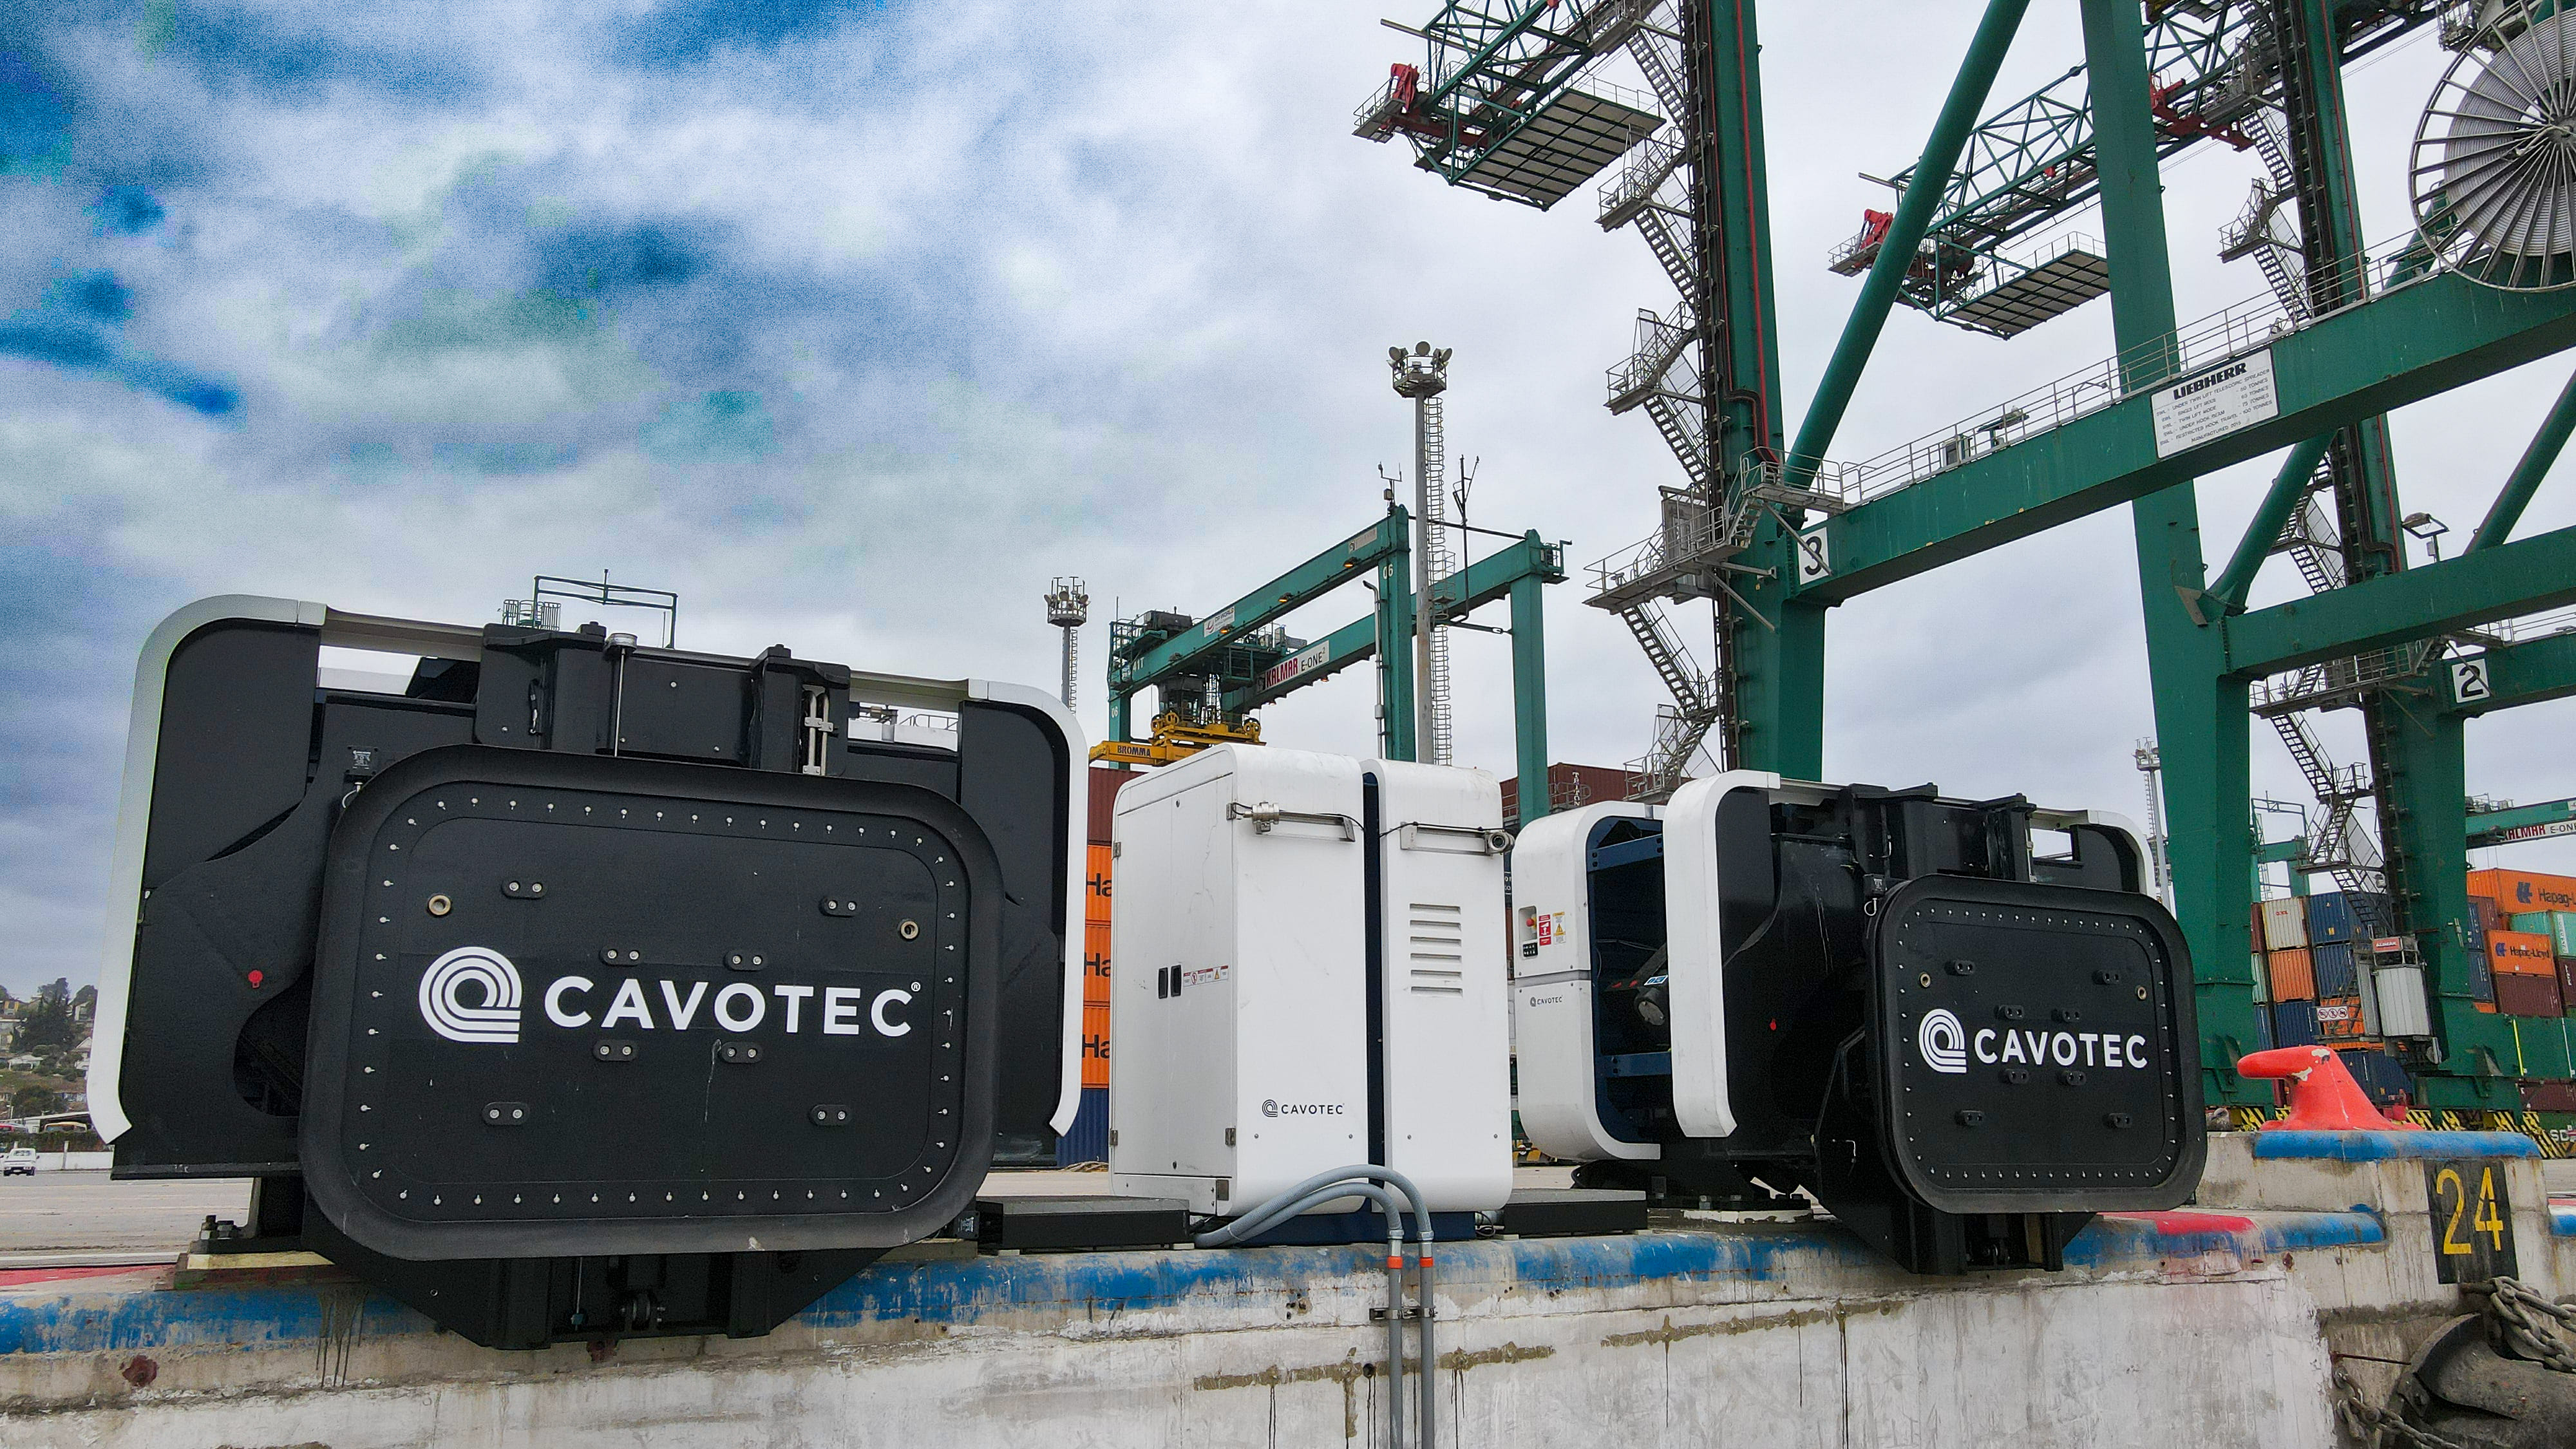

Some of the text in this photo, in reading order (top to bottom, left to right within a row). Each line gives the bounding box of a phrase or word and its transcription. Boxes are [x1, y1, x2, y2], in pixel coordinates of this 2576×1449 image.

[2173, 363, 2248, 400] LIEBHERR
[1383, 564, 1394, 580] 06
[1803, 536, 1823, 576] 3
[1266, 657, 1298, 688] KALMAR
[2459, 665, 2480, 697] 2
[1111, 706, 1118, 719] 06
[1117, 745, 1151, 758] BROMMA
[1572, 772, 1580, 806] TRITON
[1537, 996, 1562, 1005] CAVOTEC
[1974, 1028, 2148, 1069] CAVOTEC
[2436, 1166, 2504, 1255] 24
